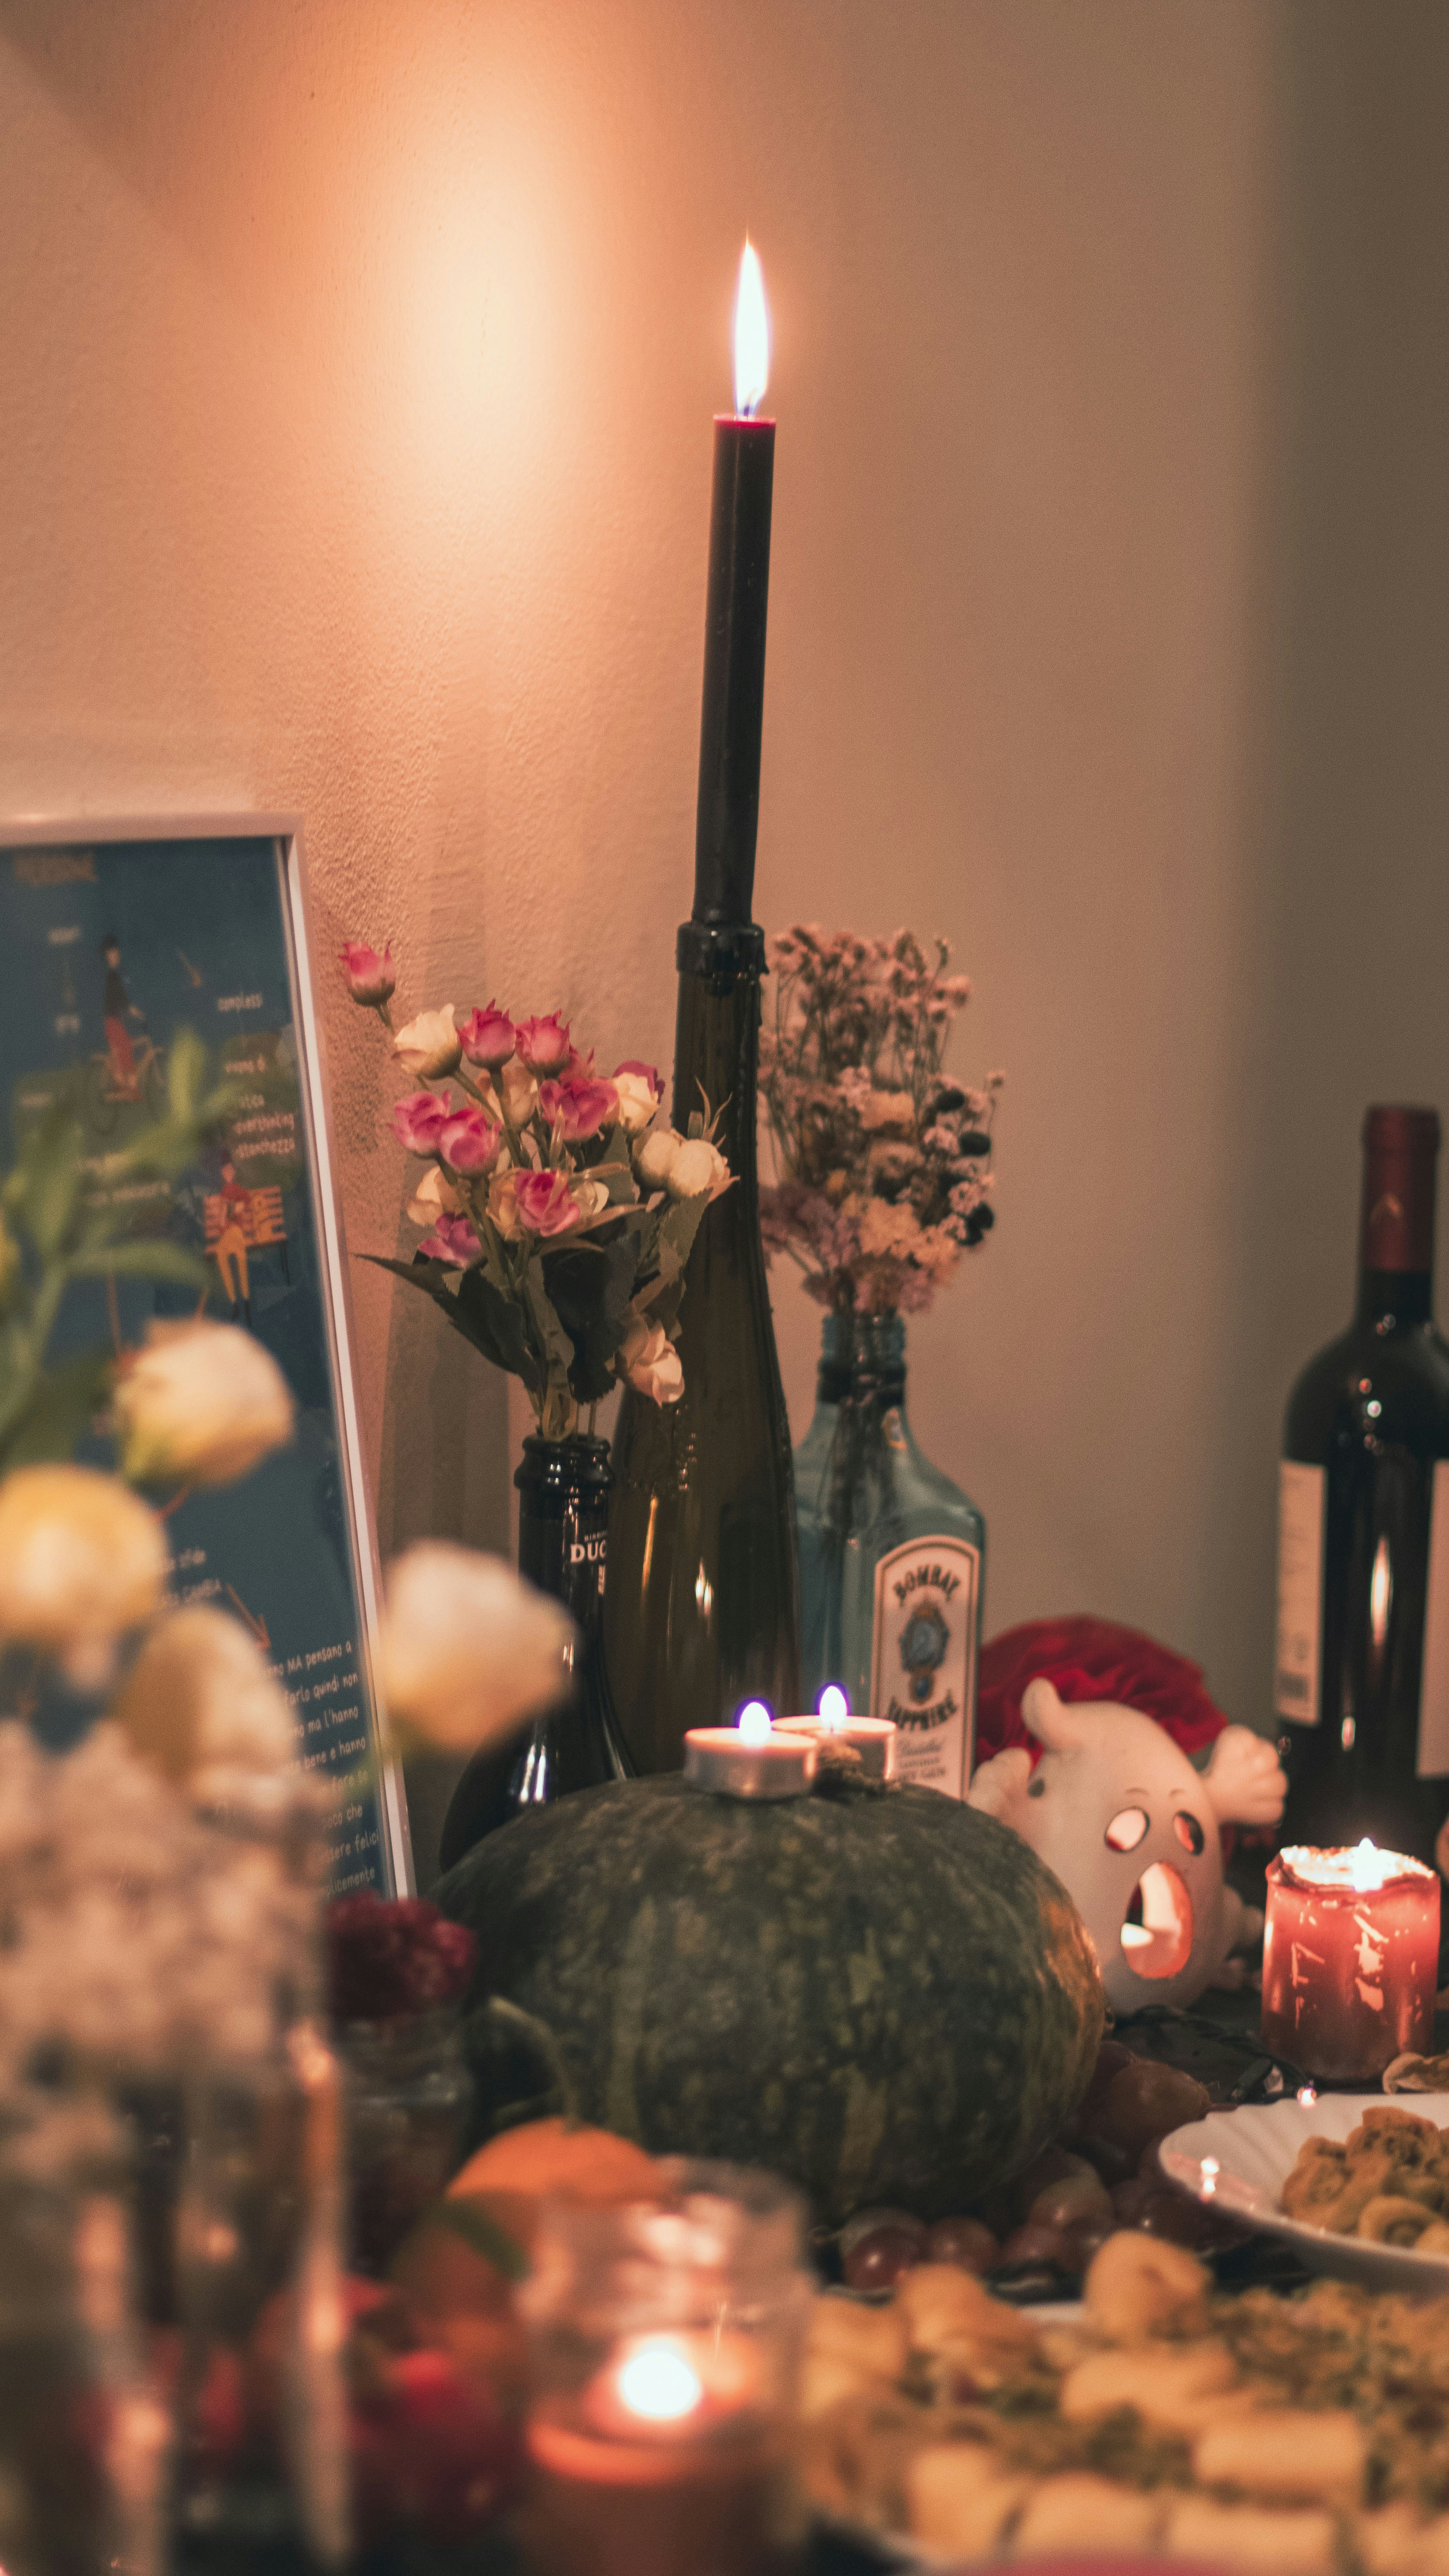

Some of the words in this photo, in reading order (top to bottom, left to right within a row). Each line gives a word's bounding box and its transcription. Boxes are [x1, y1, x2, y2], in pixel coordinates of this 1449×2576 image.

[893, 1564, 961, 1607] BOMBAY
[286, 1655, 303, 1675] MA
[306, 1643, 342, 1671] pensano
[345, 1640, 351, 1653] a
[285, 1685, 310, 1708] farlo
[313, 1673, 339, 1701] quindi
[342, 1672, 358, 1687] non
[308, 1718, 322, 1734] ma
[324, 1705, 359, 1728] l'hanno
[304, 1751, 326, 1770] bene
[331, 1748, 336, 1760] e
[339, 1737, 365, 1756] hanno
[346, 1803, 363, 1822] che
[355, 1828, 380, 1852] felici
